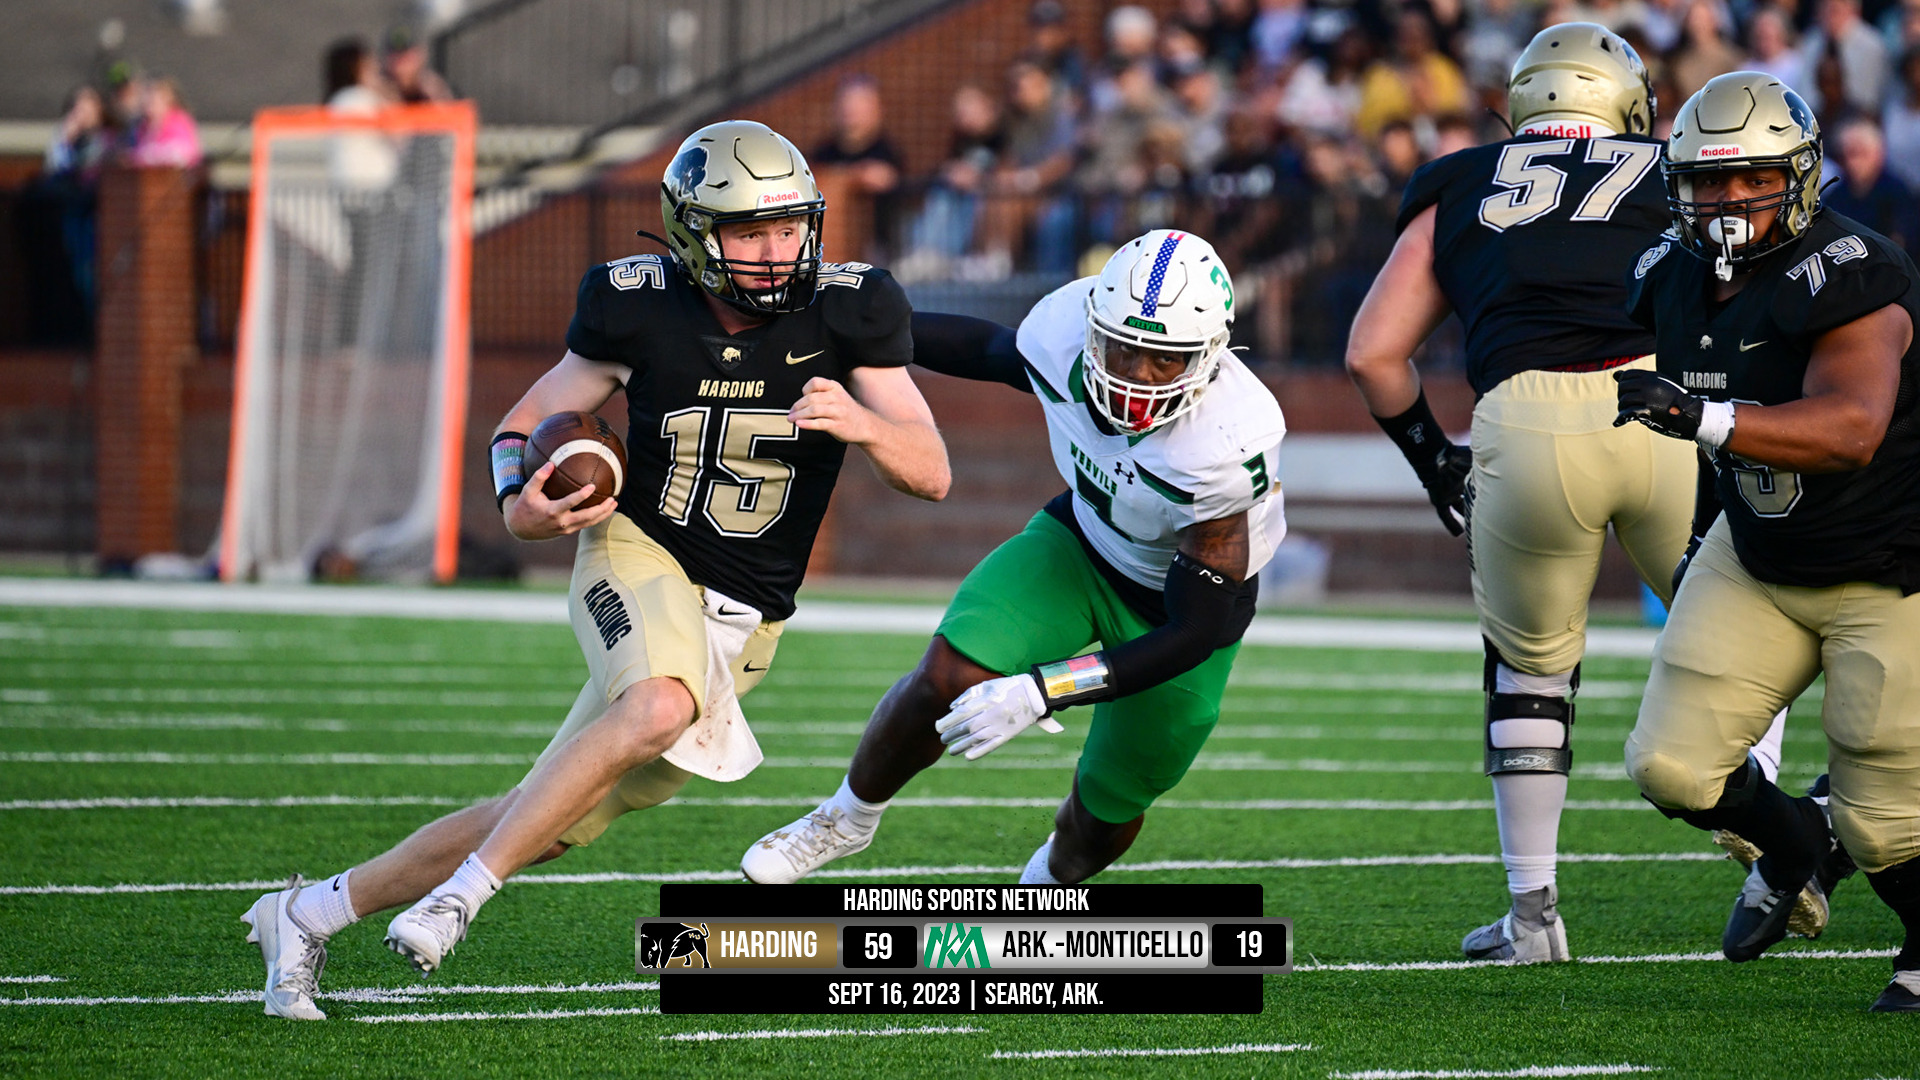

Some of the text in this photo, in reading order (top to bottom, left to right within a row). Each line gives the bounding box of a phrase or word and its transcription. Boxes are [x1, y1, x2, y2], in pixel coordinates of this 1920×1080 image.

[1701, 147, 1739, 157] Riddell
[763, 191, 799, 204] Riddell
[1479, 138, 1663, 233] 57
[1210, 265, 1233, 311] 3
[1786, 235, 1869, 297] 79
[1128, 317, 1164, 332] WEEVILS
[698, 379, 765, 398] HARDING
[1683, 371, 1727, 390] HARDING
[658, 406, 799, 539] 15
[1242, 451, 1269, 501] 3
[583, 579, 633, 651] HARDING
